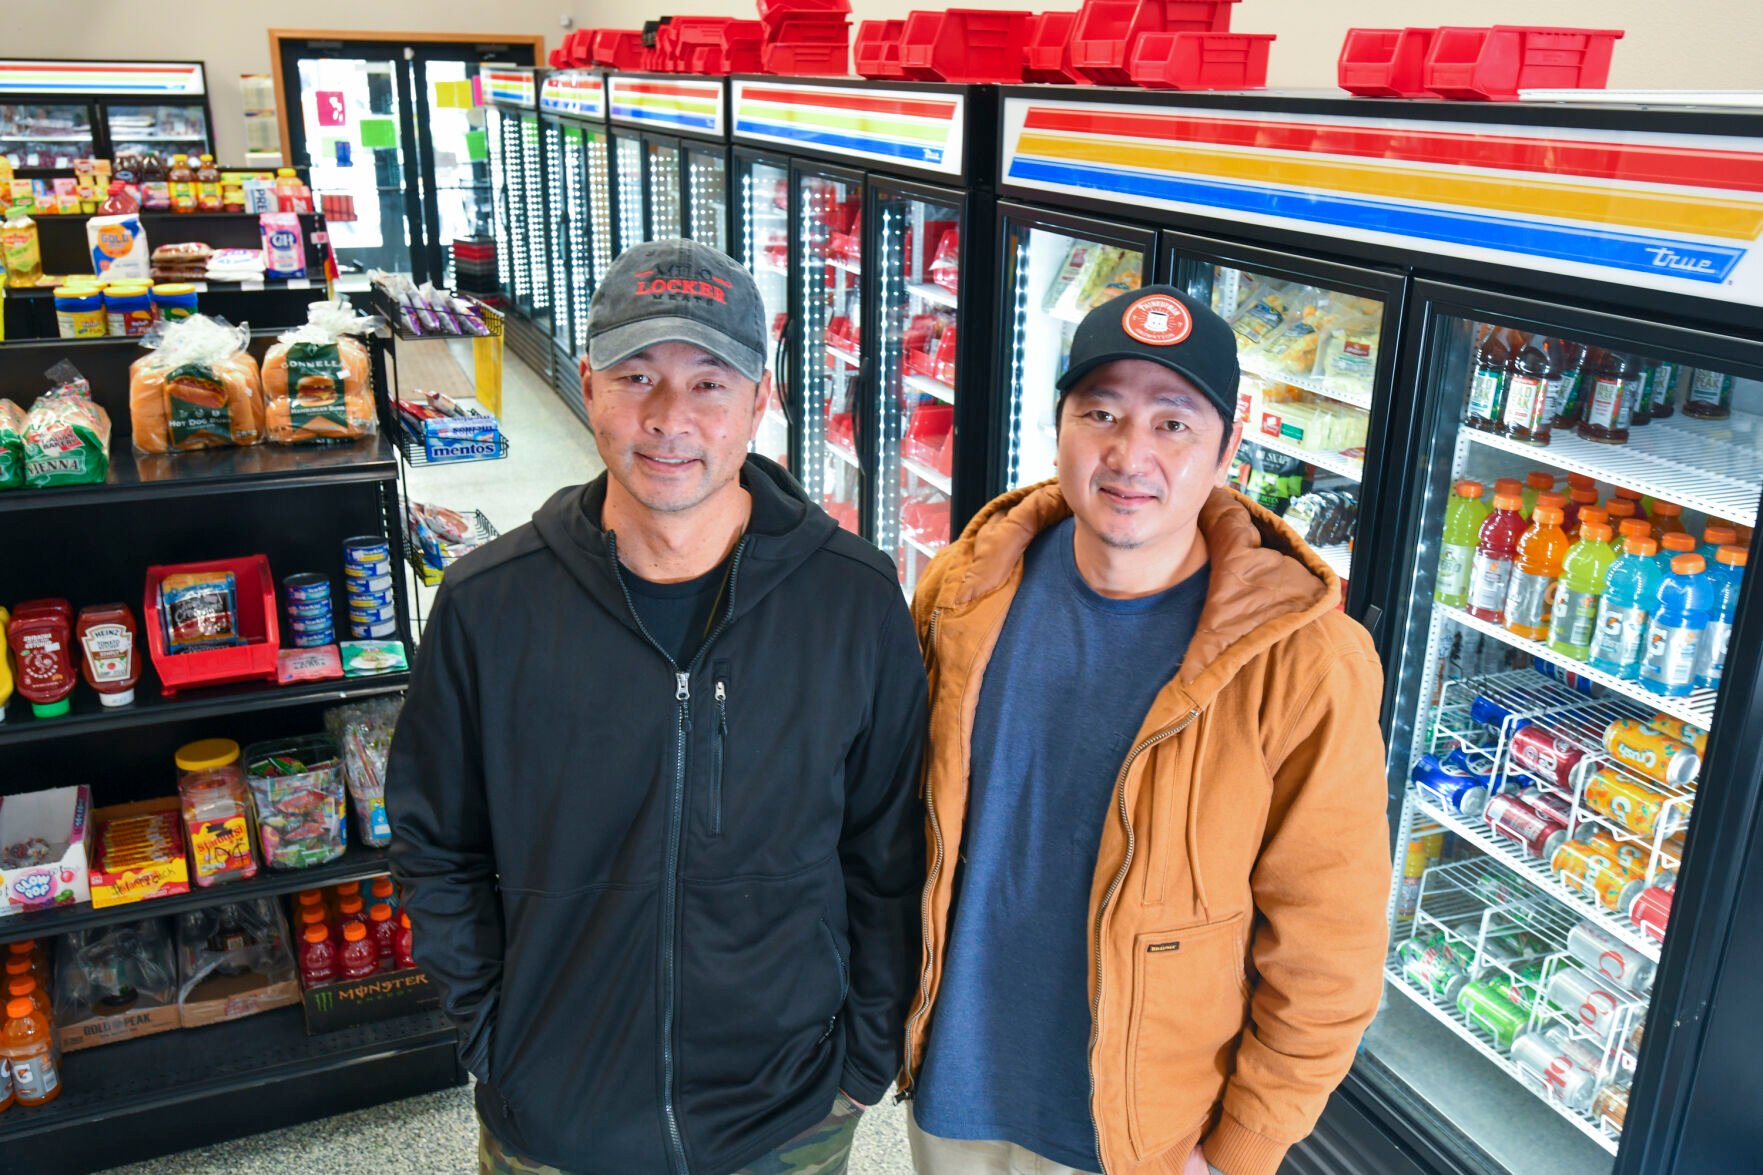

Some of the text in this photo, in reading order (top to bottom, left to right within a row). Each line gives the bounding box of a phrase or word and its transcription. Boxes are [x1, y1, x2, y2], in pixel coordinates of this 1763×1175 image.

[1644, 247, 1717, 274] true
[634, 279, 727, 304] LOCKER
[168, 418, 186, 428] HOT
[188, 417, 208, 427] DOG
[433, 444, 495, 457] mentos
[28, 459, 79, 475] VIENNA
[95, 629, 119, 638] HEINZ
[15, 874, 51, 894] BLOW
[25, 883, 51, 899] POP
[338, 974, 428, 1001] MONSTER
[84, 1013, 151, 1035] GOLD PEAK
